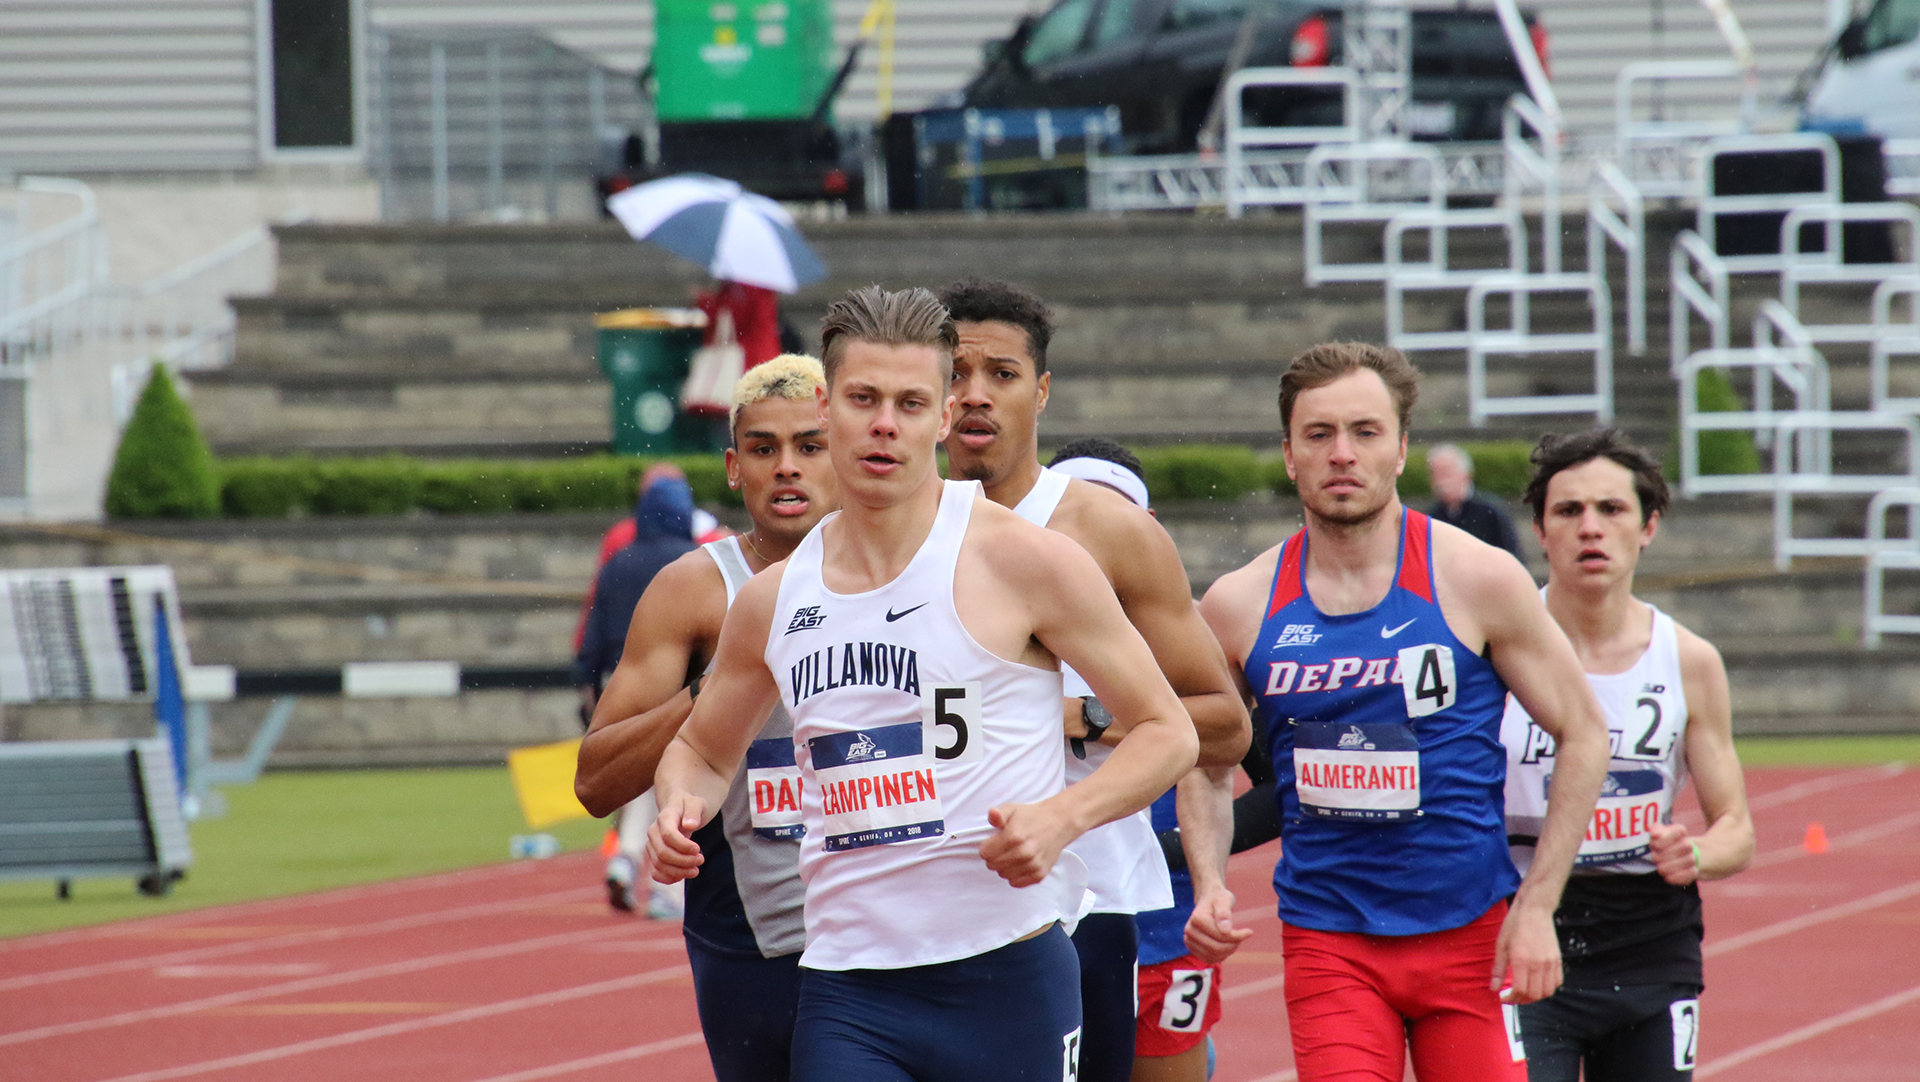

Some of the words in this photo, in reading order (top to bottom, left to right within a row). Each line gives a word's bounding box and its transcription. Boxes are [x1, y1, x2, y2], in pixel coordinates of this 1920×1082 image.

[788, 615, 827, 630] EAST
[794, 605, 821, 618] BIG
[1276, 634, 1323, 644] EAST
[1283, 624, 1315, 635] BIG
[791, 642, 921, 707] VILLANOVA
[1415, 648, 1449, 708] 4
[935, 687, 969, 760] 5
[1634, 697, 1662, 756] 2
[1301, 762, 1416, 790] ALMERANTI
[821, 768, 937, 816] LAMPINEN
[775, 828, 791, 836] SPIRE
[907, 826, 922, 835] 2018
[1171, 973, 1204, 1028] 3
